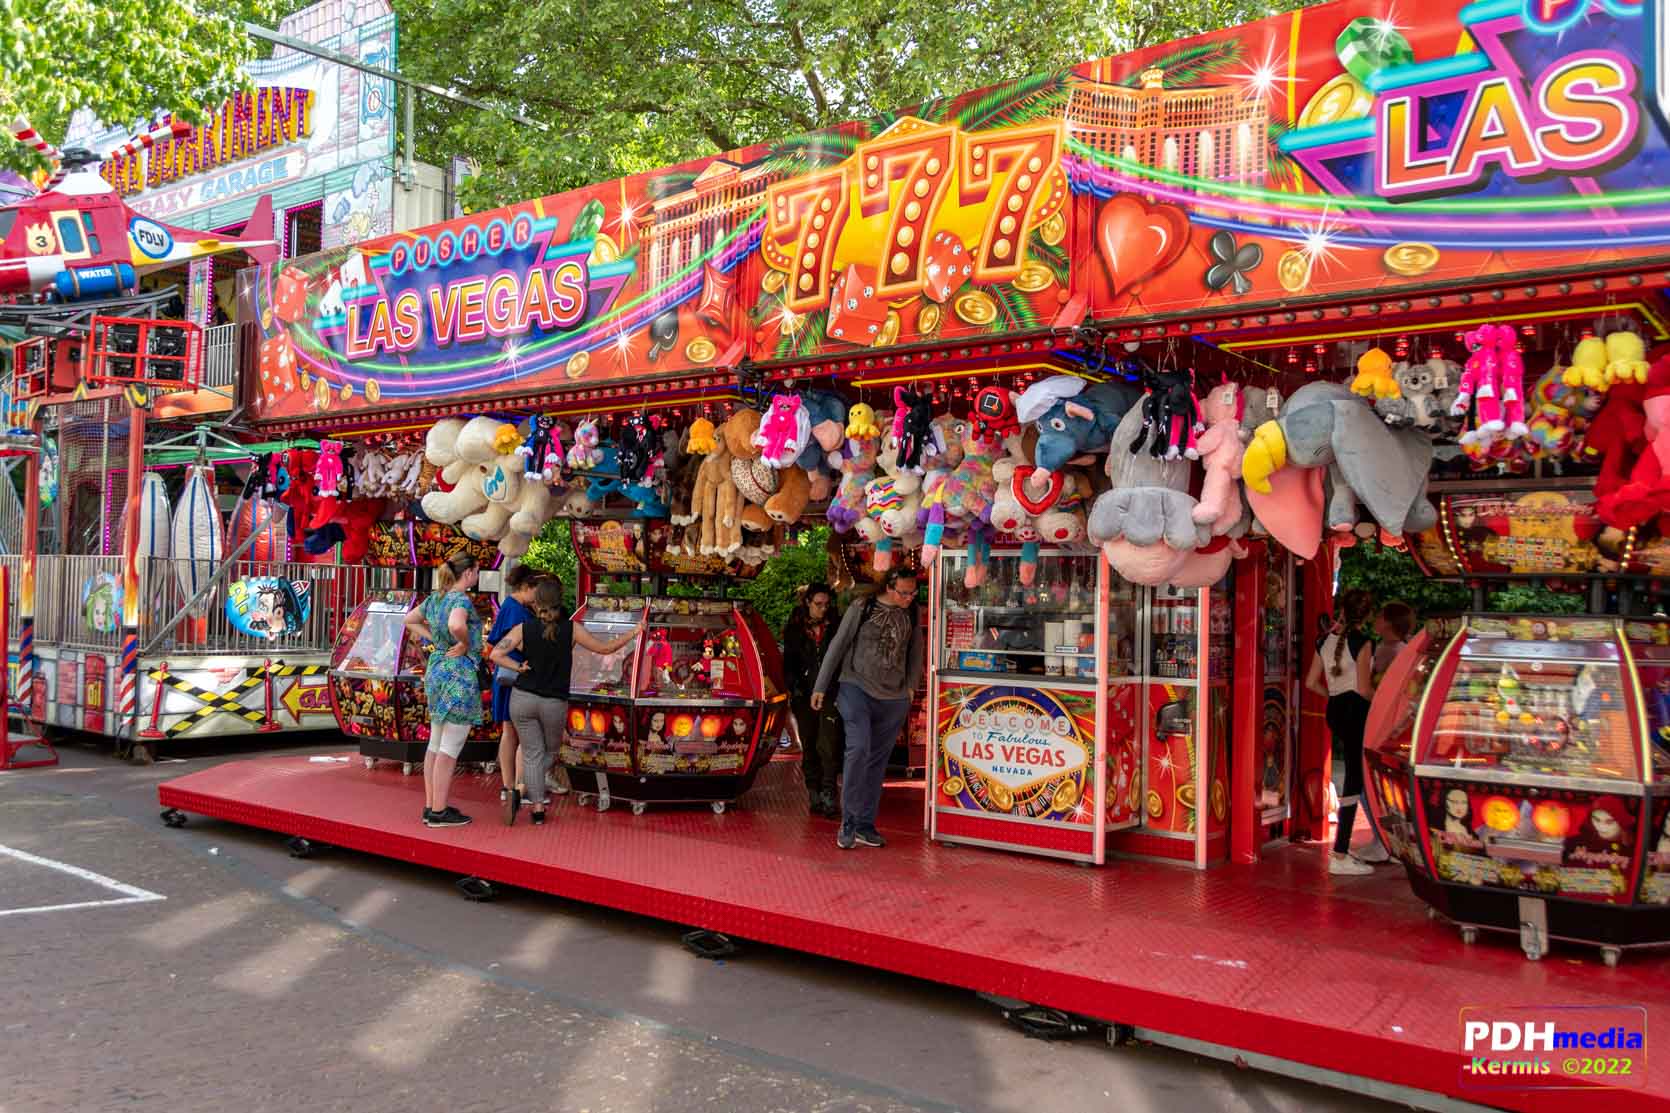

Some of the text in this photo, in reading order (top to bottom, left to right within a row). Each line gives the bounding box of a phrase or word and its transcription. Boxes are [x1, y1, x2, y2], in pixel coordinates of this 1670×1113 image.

[1382, 57, 1630, 190] LAS
[201, 156, 289, 199] GARAGE
[36, 235, 47, 248] 3
[138, 229, 165, 247] FDLV
[393, 221, 530, 271] PUSHER
[78, 268, 113, 279] WATER
[346, 260, 589, 357] LAS VEGAS
[962, 711, 1066, 732] WELCOME
[972, 731, 1051, 746] TO Fabulous
[962, 741, 1067, 768] LAS VEGAS
[991, 765, 1033, 776] NEVADA
